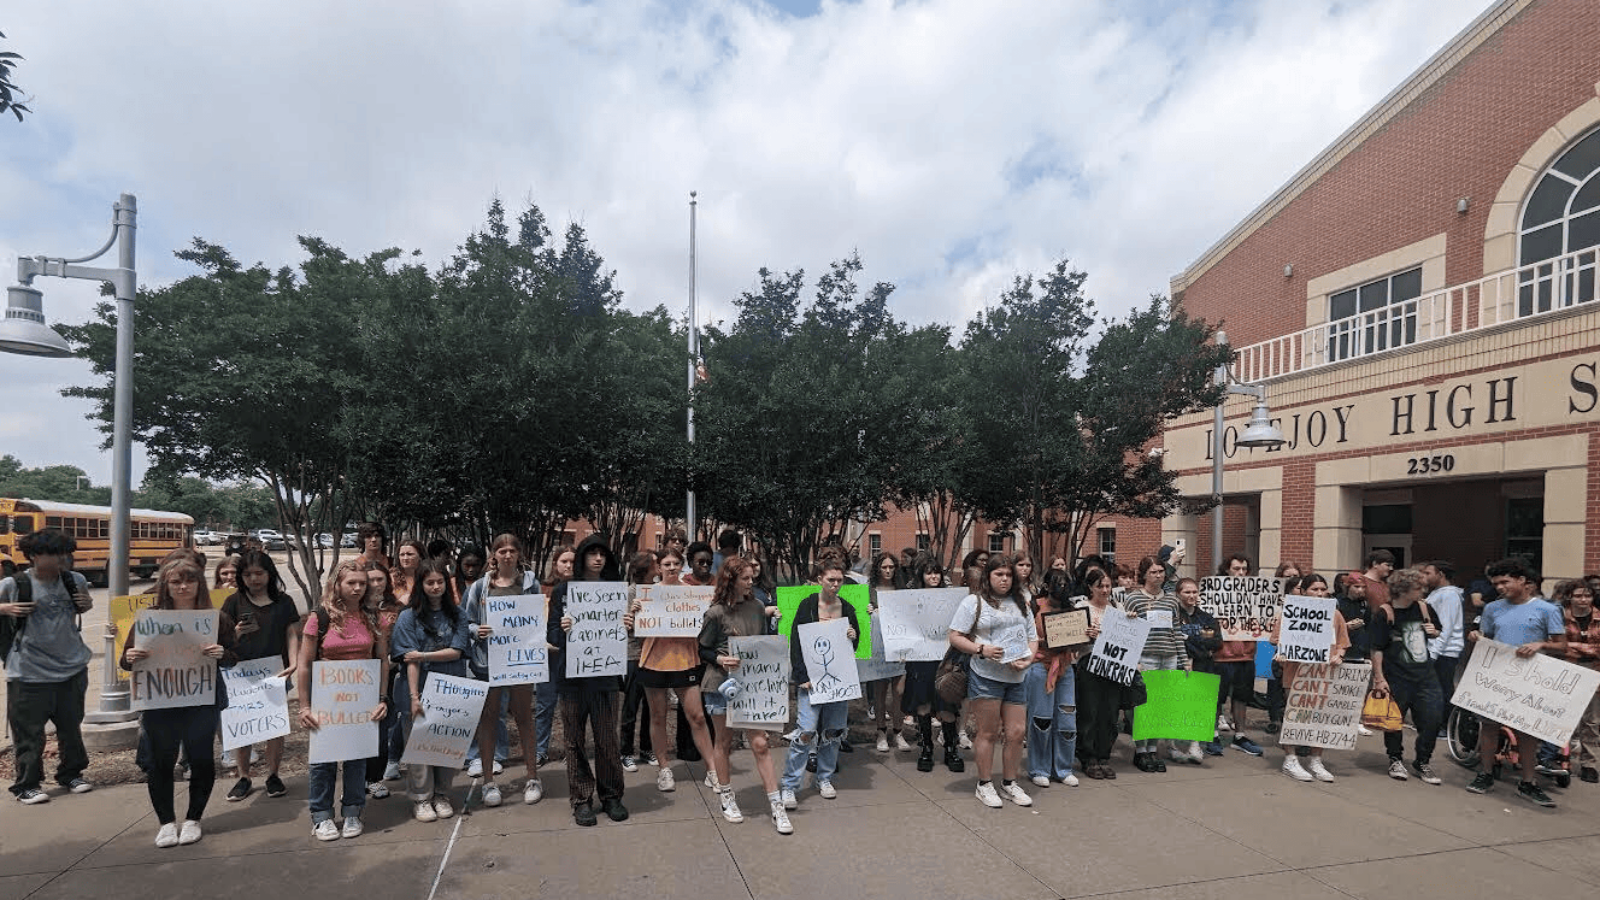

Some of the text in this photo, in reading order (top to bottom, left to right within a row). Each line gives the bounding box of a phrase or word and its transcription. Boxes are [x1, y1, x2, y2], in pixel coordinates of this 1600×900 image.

[1388, 376, 1519, 437] HIGH
[1569, 361, 1599, 415] S
[1407, 454, 1455, 475] 2350
[1200, 577, 1281, 593] 3RD GRADERS
[640, 587, 654, 602] I
[489, 600, 516, 612] HOW
[1217, 605, 1253, 616] LEARN
[1258, 604, 1275, 617] TO
[1284, 604, 1331, 621] SCHOOL
[503, 615, 538, 628] MANY
[639, 616, 662, 629] NOT
[1215, 616, 1237, 630] OP
[1288, 620, 1323, 633] ZONE
[507, 647, 546, 662] LIVES
[1103, 641, 1129, 661] NOT
[1481, 646, 1498, 669] I
[576, 655, 621, 675] IKEA
[132, 663, 213, 701] ENOUGH
[319, 668, 374, 686] BOOKS
[1338, 667, 1372, 682] DRINK
[740, 680, 767, 694] ore
[318, 710, 373, 726] BULLET
[1286, 708, 1312, 725] CAN
[227, 712, 288, 738] VOTERS
[427, 723, 472, 738] ACTION
[1282, 728, 1315, 742] REVIVE
